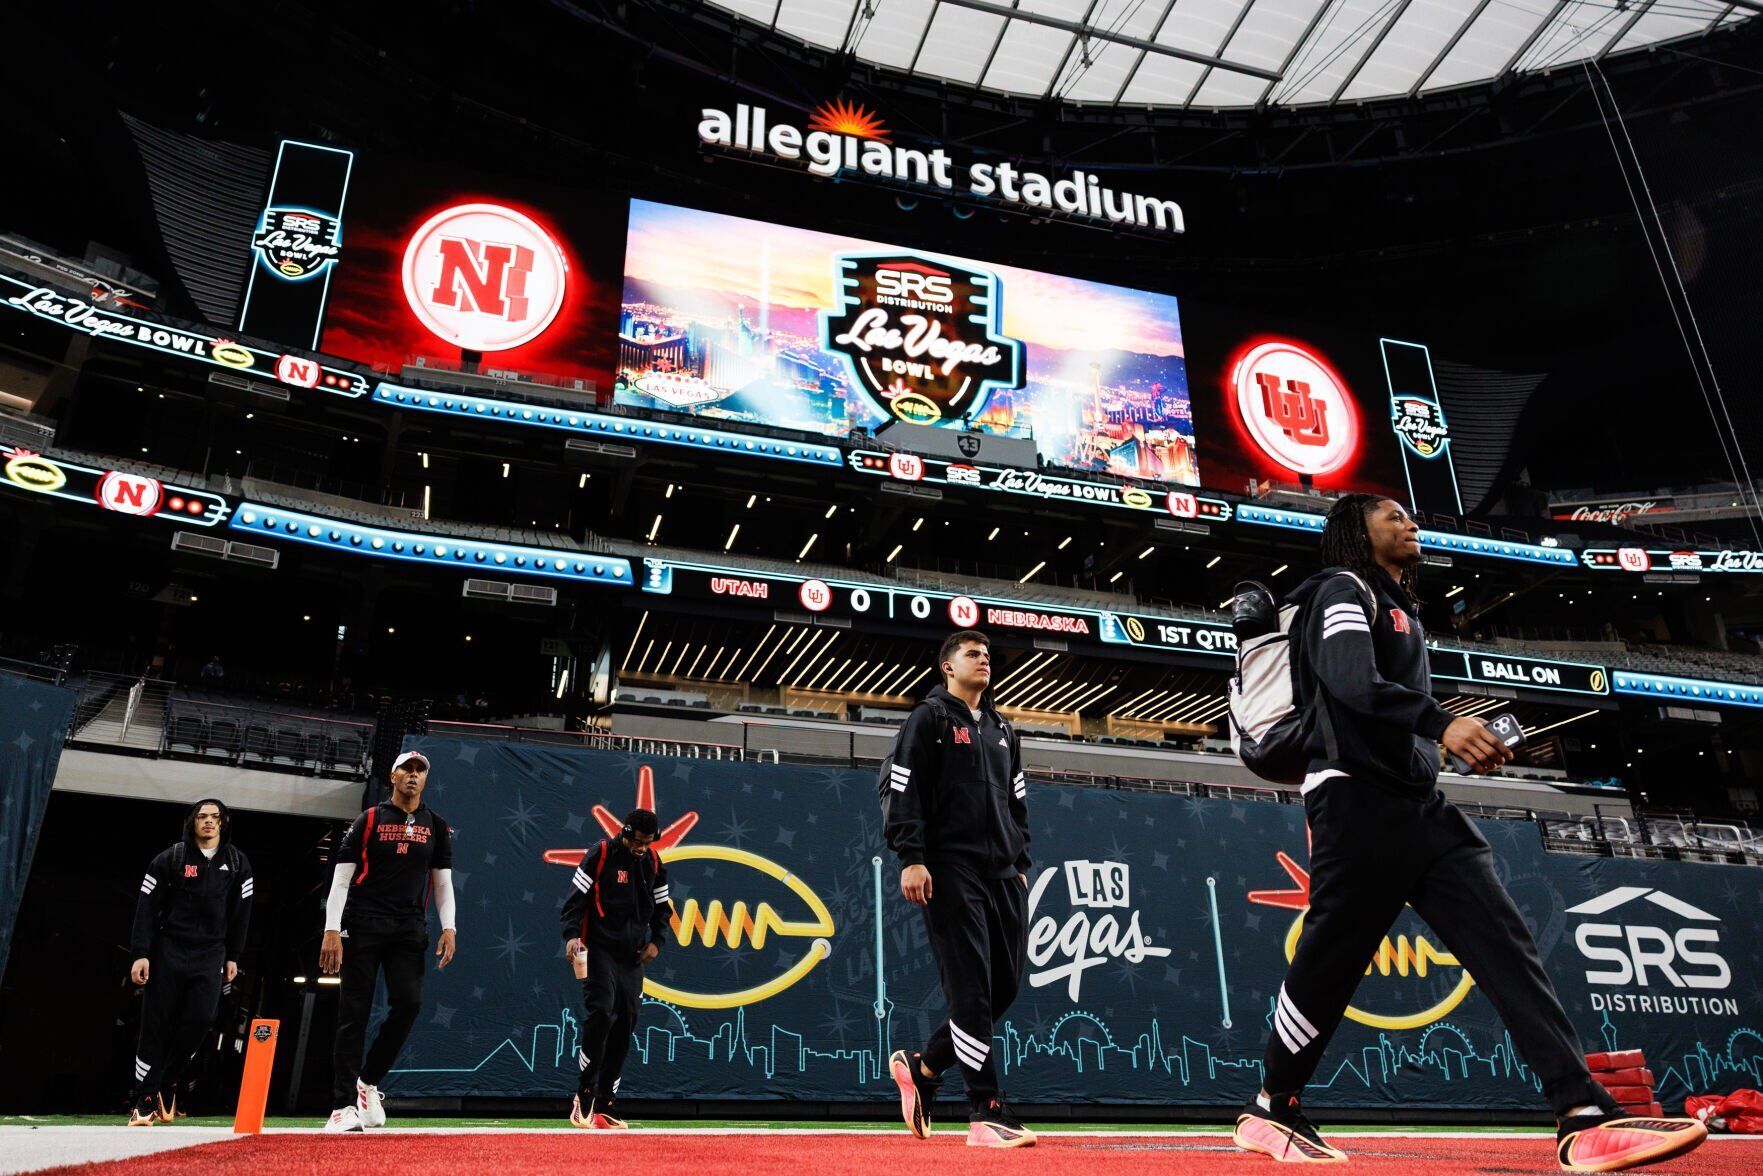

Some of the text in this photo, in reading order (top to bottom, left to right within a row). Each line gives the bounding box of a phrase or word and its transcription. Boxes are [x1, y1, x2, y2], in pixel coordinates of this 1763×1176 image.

[698, 103, 1186, 234] allegiant stadium
[283, 215, 321, 231] SRS
[256, 230, 338, 258] Las Vegas
[280, 250, 307, 260] BOWL
[429, 235, 533, 322] N
[875, 269, 954, 303] SRS
[876, 295, 953, 314] DISTRIBUTION
[8, 288, 64, 314] Las
[65, 298, 134, 336] Vegas
[137, 326, 206, 356] BOWL
[835, 308, 1002, 376] Las Vegas
[288, 362, 309, 382] N
[882, 358, 934, 380] BOWL
[646, 383, 710, 400] LAS VEGAS
[1396, 416, 1447, 438] Las Vegas
[959, 437, 979, 451] 43
[946, 466, 981, 482] SRS
[114, 480, 146, 507] N
[989, 469, 1119, 503] Las Vegas BOWL
[1176, 498, 1189, 512] N
[1669, 554, 1702, 567] SRS
[1710, 550, 1742, 571] Las
[710, 577, 769, 599] UTAH
[850, 589, 871, 612] 0
[911, 595, 931, 619] 0
[957, 604, 971, 620] N
[987, 608, 1090, 634] NEBRASKA
[1157, 624, 1239, 650] 1ST QTR
[1481, 660, 1561, 684] BALL ON
[953, 725, 972, 744] N
[397, 842, 409, 855] N
[184, 864, 198, 878] N
[617, 870, 629, 883] N
[1070, 865, 1125, 904] LAS
[1574, 922, 1732, 990] SRS
[1590, 993, 1740, 1016] DISTRIBUTION
